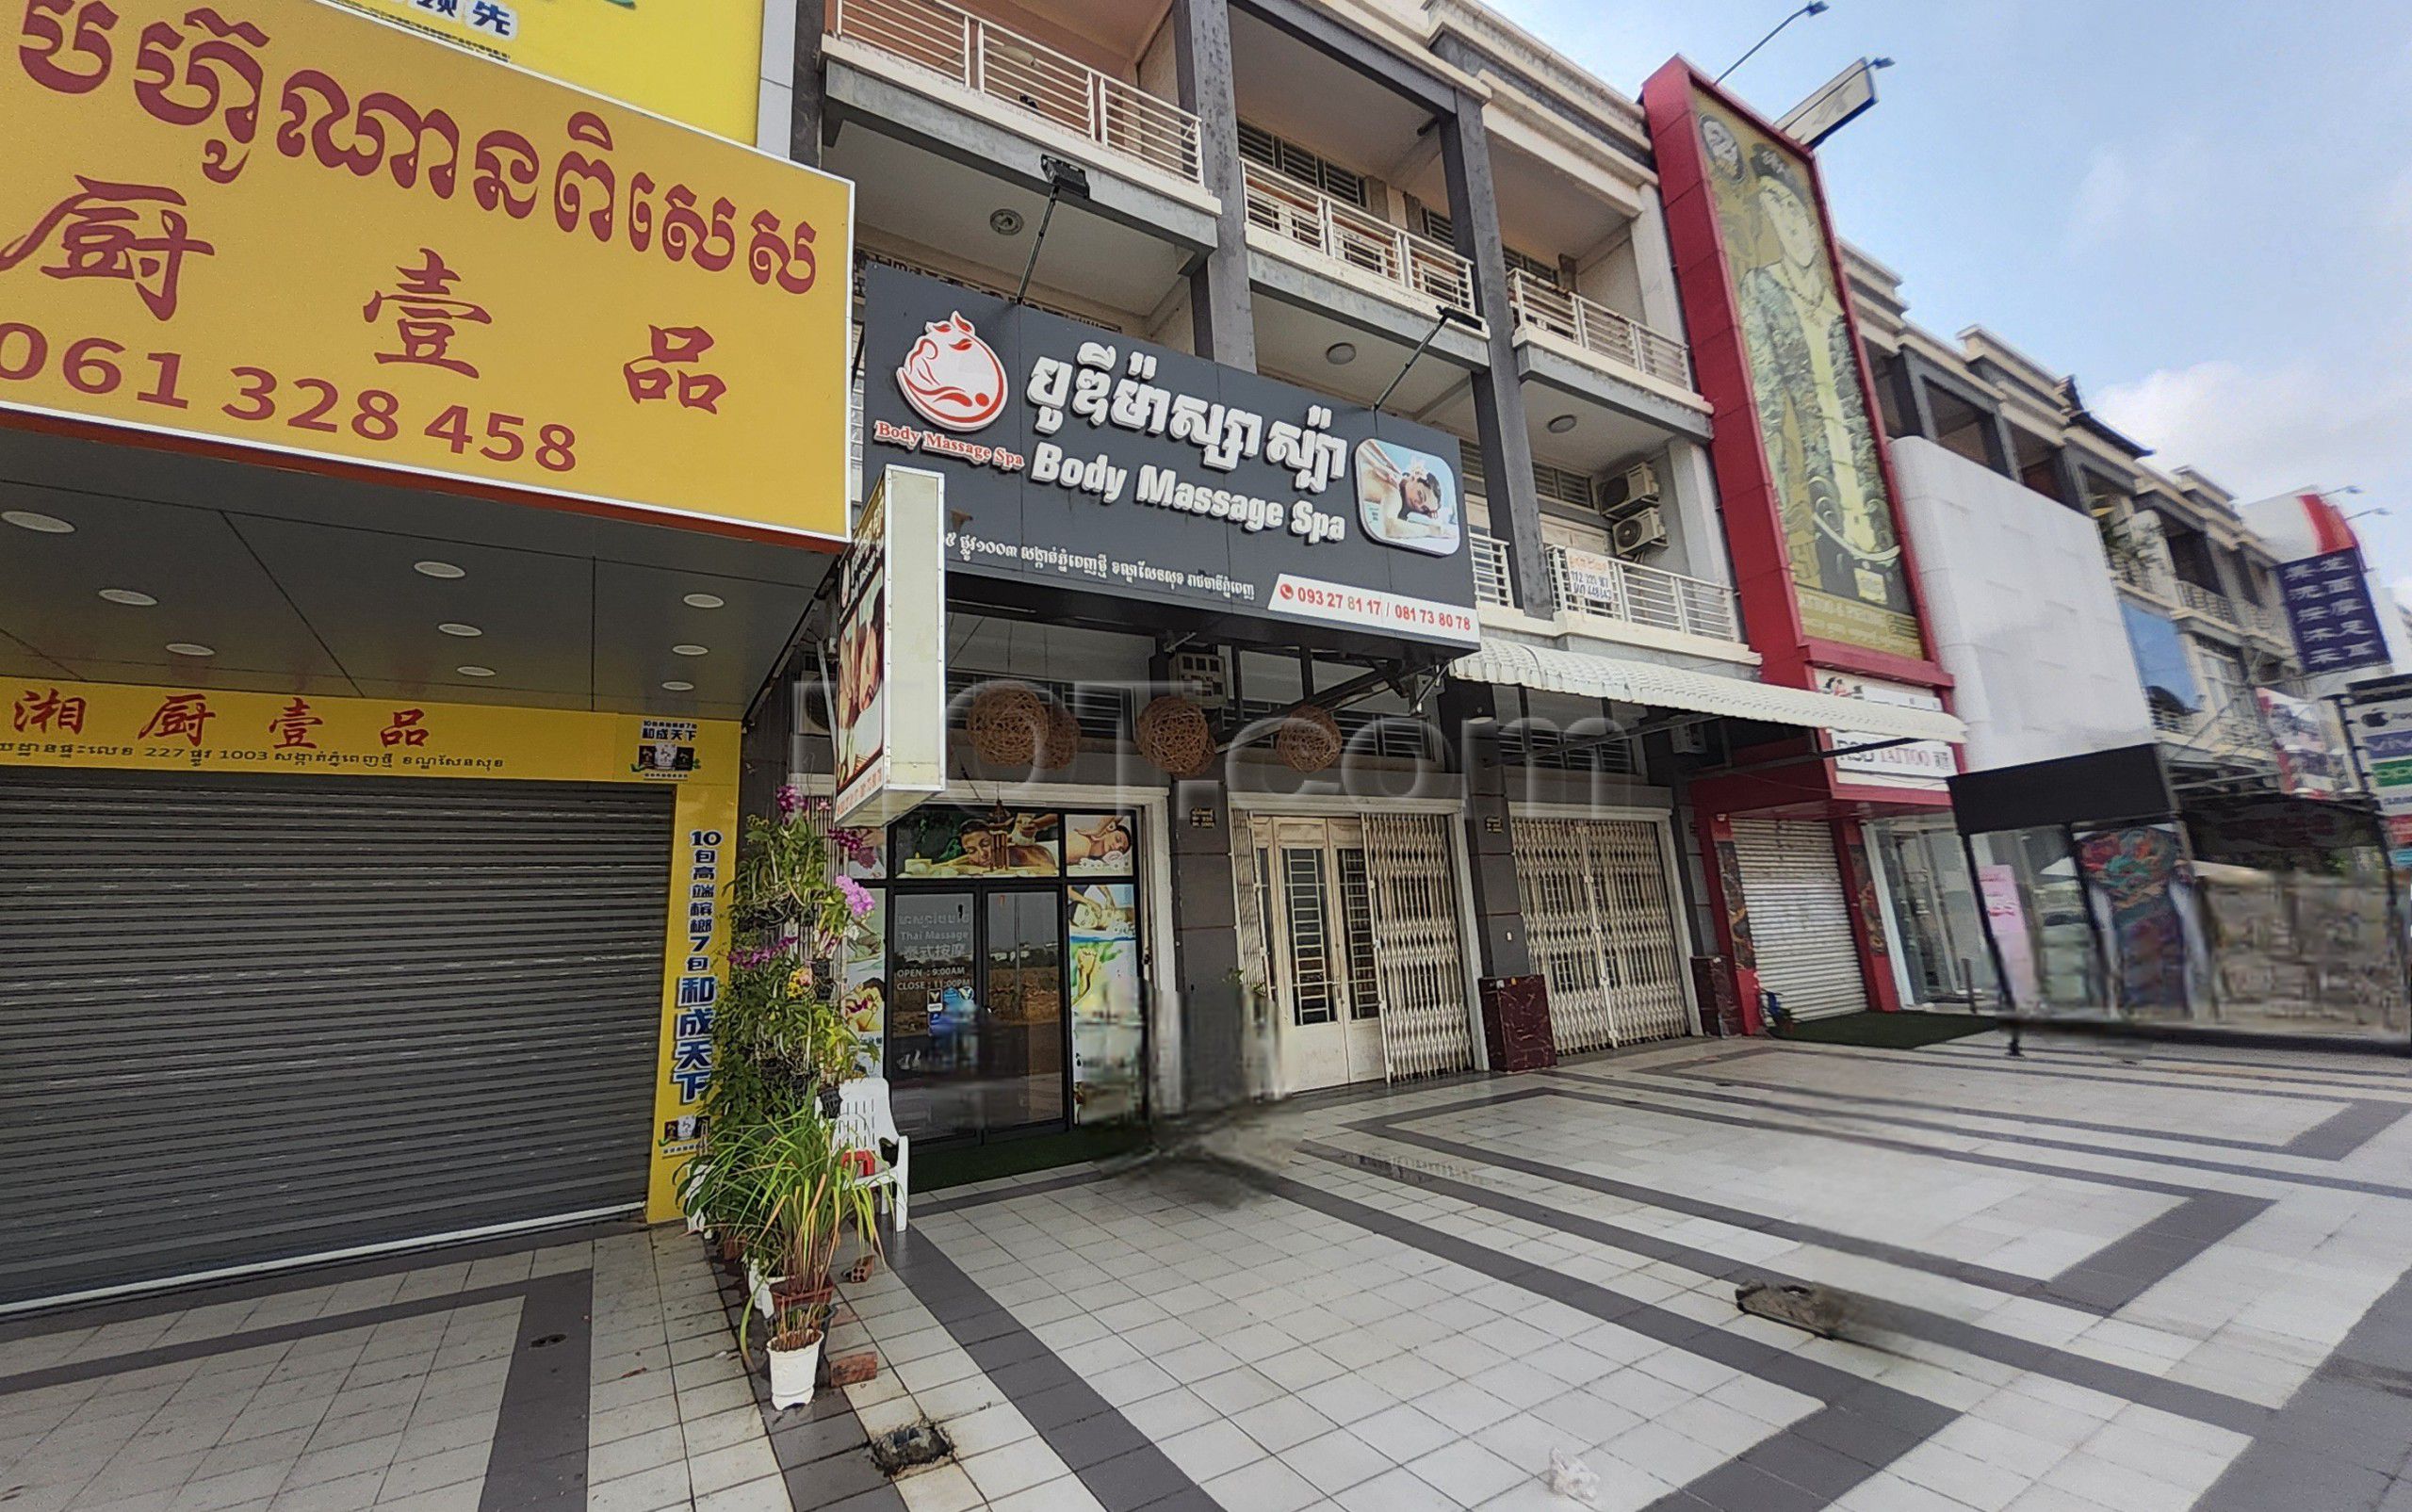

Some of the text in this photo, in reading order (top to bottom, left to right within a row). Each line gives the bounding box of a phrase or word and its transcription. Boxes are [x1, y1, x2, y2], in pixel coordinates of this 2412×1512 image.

[0, 322, 578, 473] 061 328 458
[876, 421, 1024, 467] Body Massage Spa
[1031, 440, 1346, 545] Body Massage Spa
[1296, 586, 1325, 606] 093
[1327, 592, 1344, 610] 27
[1347, 595, 1362, 612] 81
[1367, 599, 1381, 615] 17
[1394, 604, 1416, 622] 081
[1419, 608, 1435, 625] 73
[1439, 612, 1454, 628] 80
[1456, 615, 1471, 631] 78
[13, 688, 430, 750] 湘厨壹品
[142, 747, 186, 758] 227
[220, 749, 269, 761] 1003
[900, 930, 969, 943] Thai Massage
[896, 968, 923, 979] OPEN
[932, 967, 966, 977] 9:00AM
[896, 981, 926, 991] CLOSE
